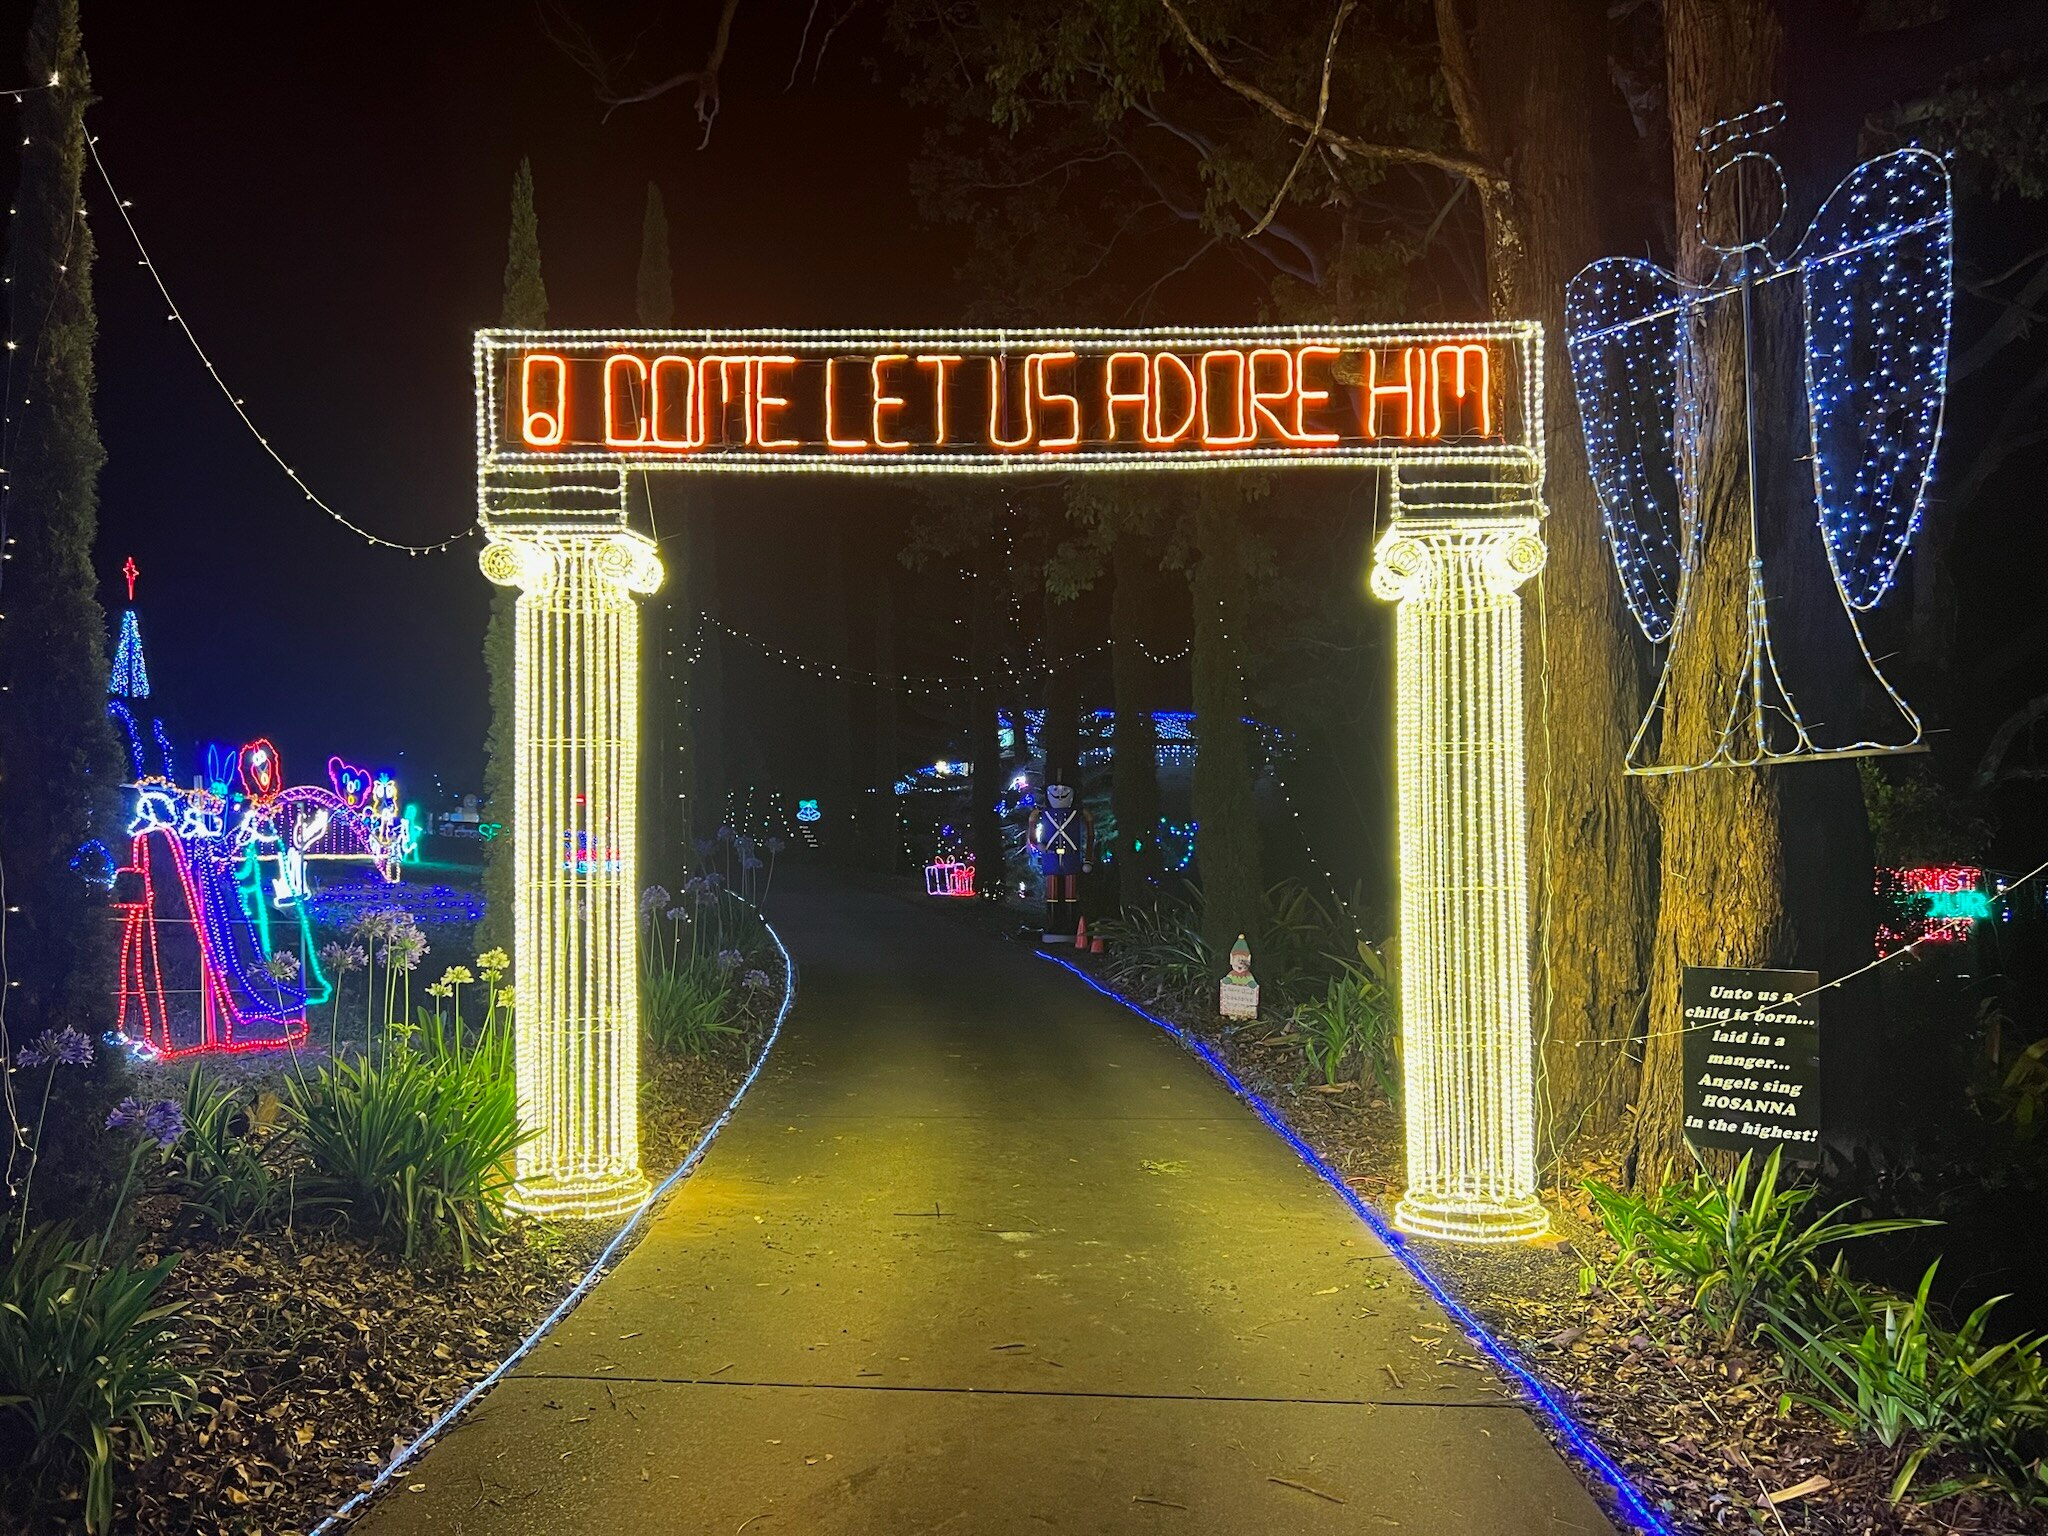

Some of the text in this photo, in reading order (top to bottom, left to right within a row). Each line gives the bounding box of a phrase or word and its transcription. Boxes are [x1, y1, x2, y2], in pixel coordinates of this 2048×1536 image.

[604, 353, 799, 447] COME
[826, 354, 962, 447] LET
[989, 351, 1080, 446] US
[1105, 345, 1341, 444] ADORE
[1367, 344, 1491, 439] HIM
[1709, 986, 1795, 1004] Unto us a
[1685, 1006, 1731, 1021] child
[1733, 1008, 1751, 1022] is
[1712, 1030, 1786, 1047] laid in a
[1698, 1073, 1803, 1097] Angels sing
[1702, 1094, 1797, 1116] HOSANNA
[1684, 1115, 1819, 1143] in the highest!
